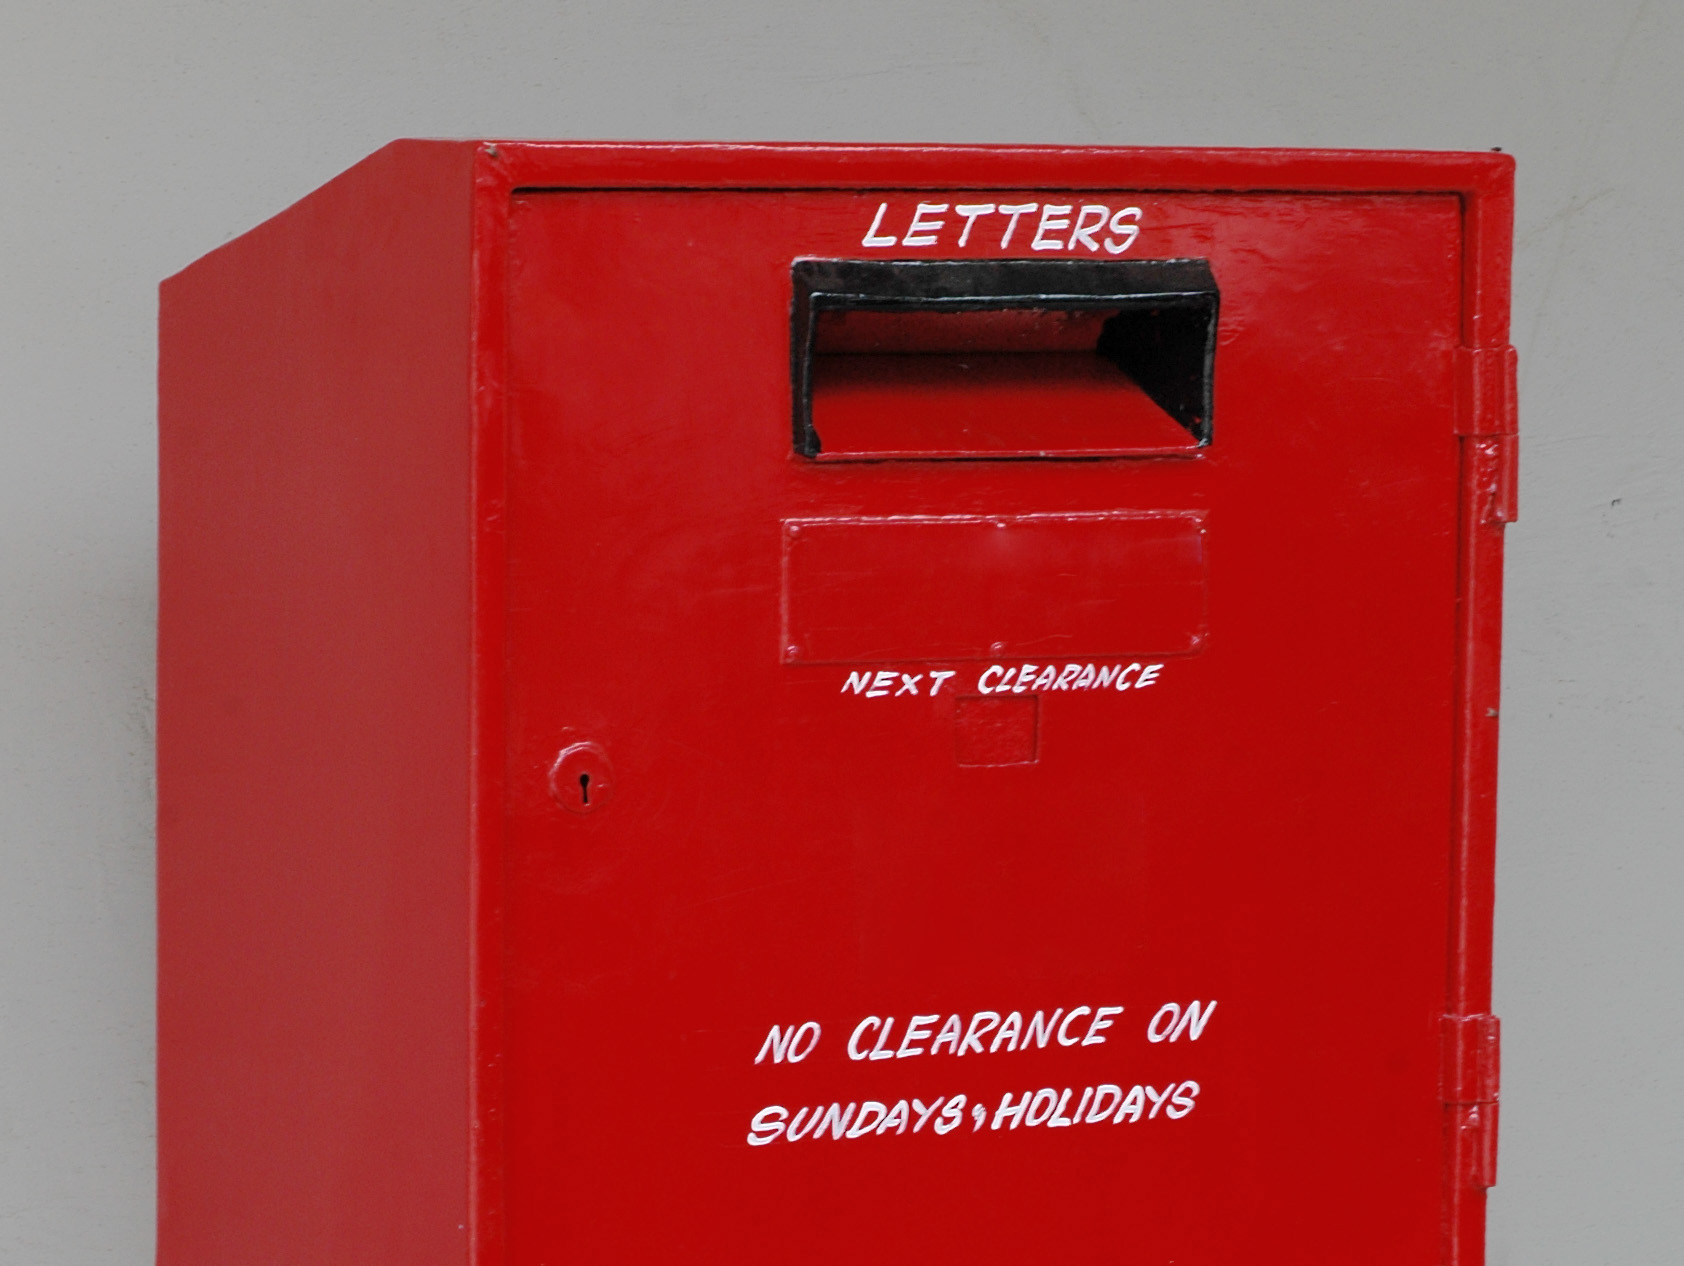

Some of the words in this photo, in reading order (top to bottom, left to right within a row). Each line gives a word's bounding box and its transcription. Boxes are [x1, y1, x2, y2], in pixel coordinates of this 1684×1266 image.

[861, 202, 1143, 254] LETTERS
[841, 670, 956, 697] NEXT
[977, 662, 1165, 695] CLEARANCE
[754, 1021, 821, 1065] NO
[847, 1005, 1125, 1061] CLEARANCE
[1147, 999, 1218, 1043] ON
